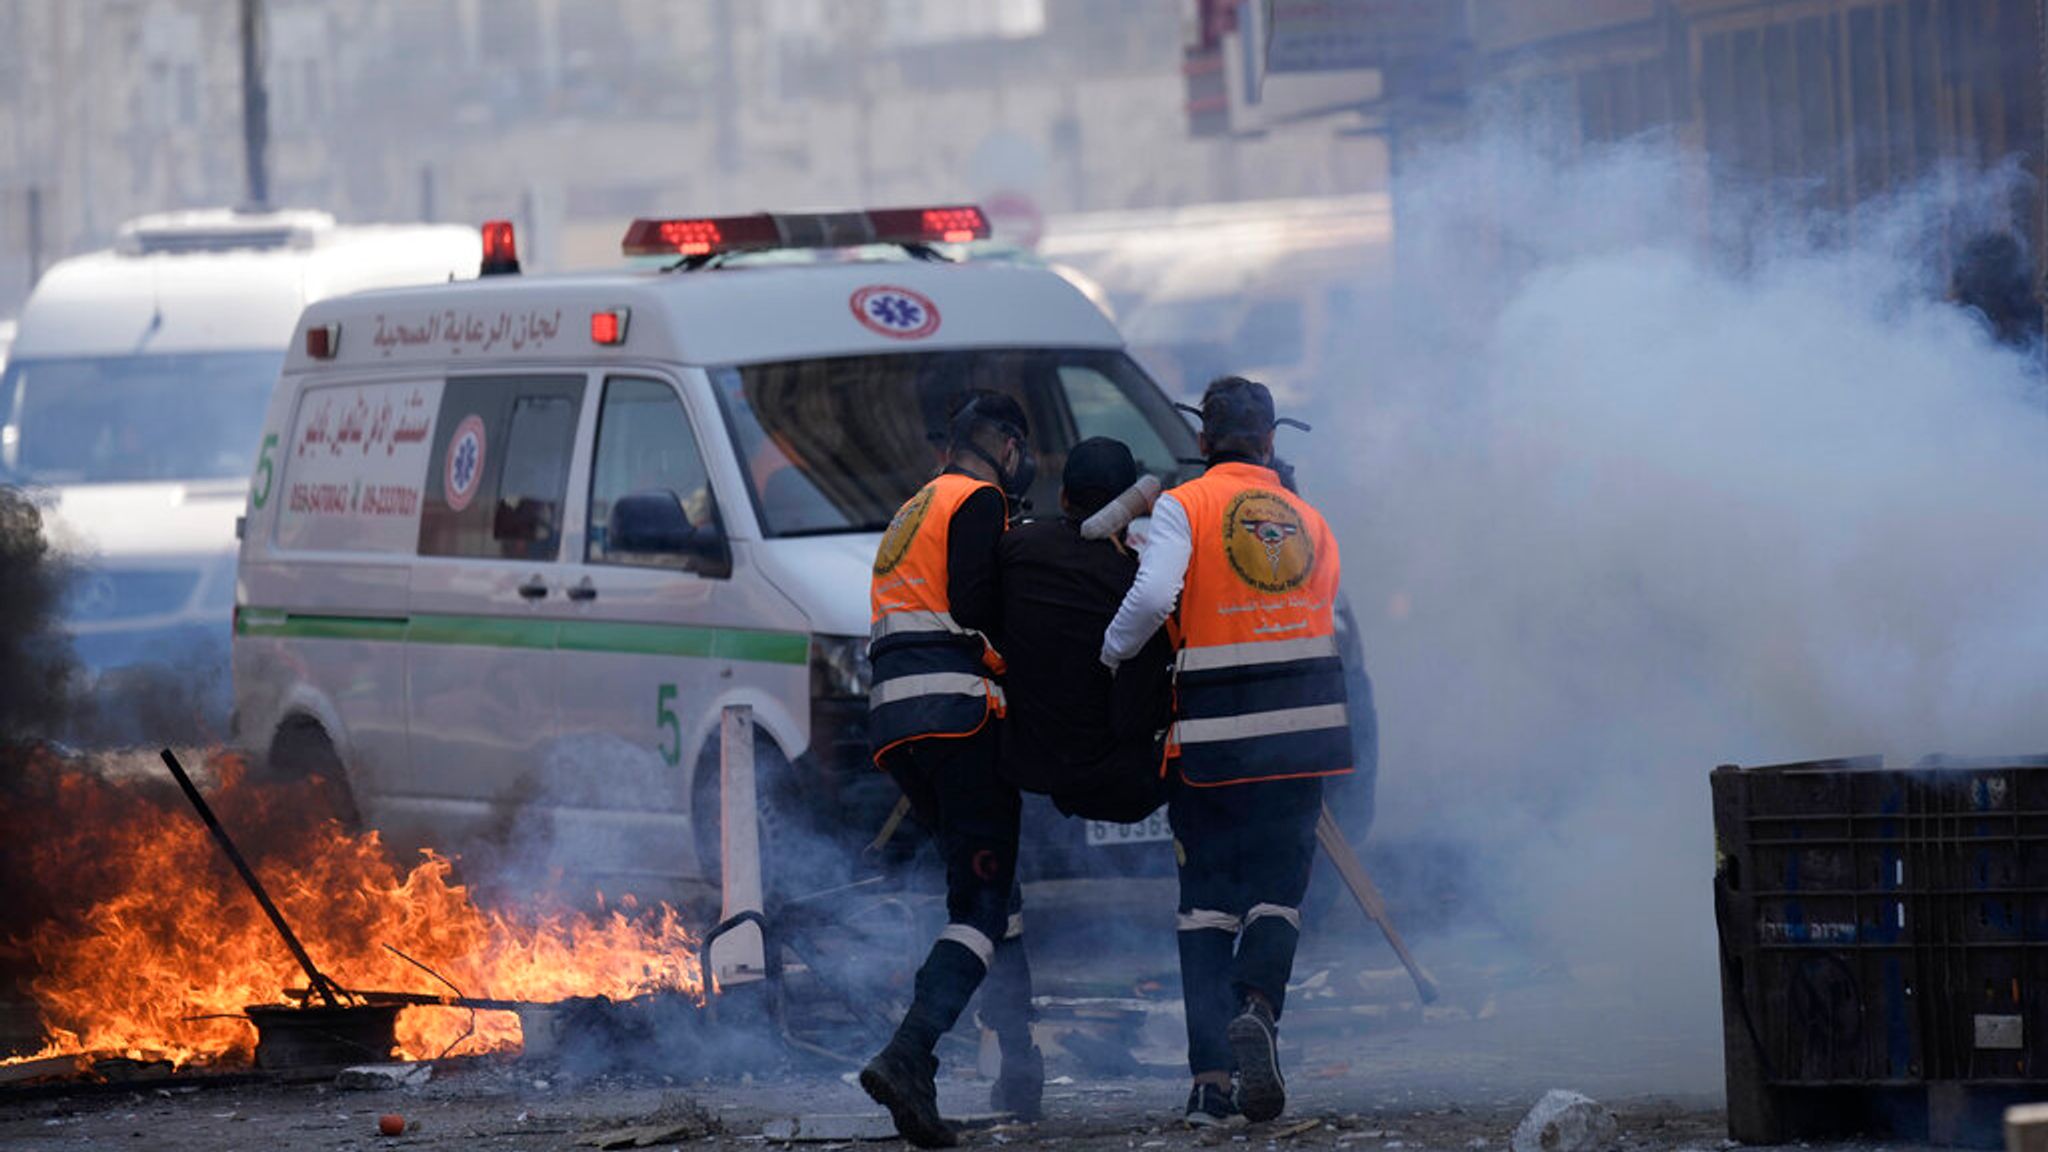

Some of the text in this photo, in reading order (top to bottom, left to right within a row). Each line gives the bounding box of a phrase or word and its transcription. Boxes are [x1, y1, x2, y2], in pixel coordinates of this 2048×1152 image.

[373, 307, 561, 356] لجان الرعاية الصحية
[253, 433, 278, 509] 5
[656, 683, 681, 768] 5
